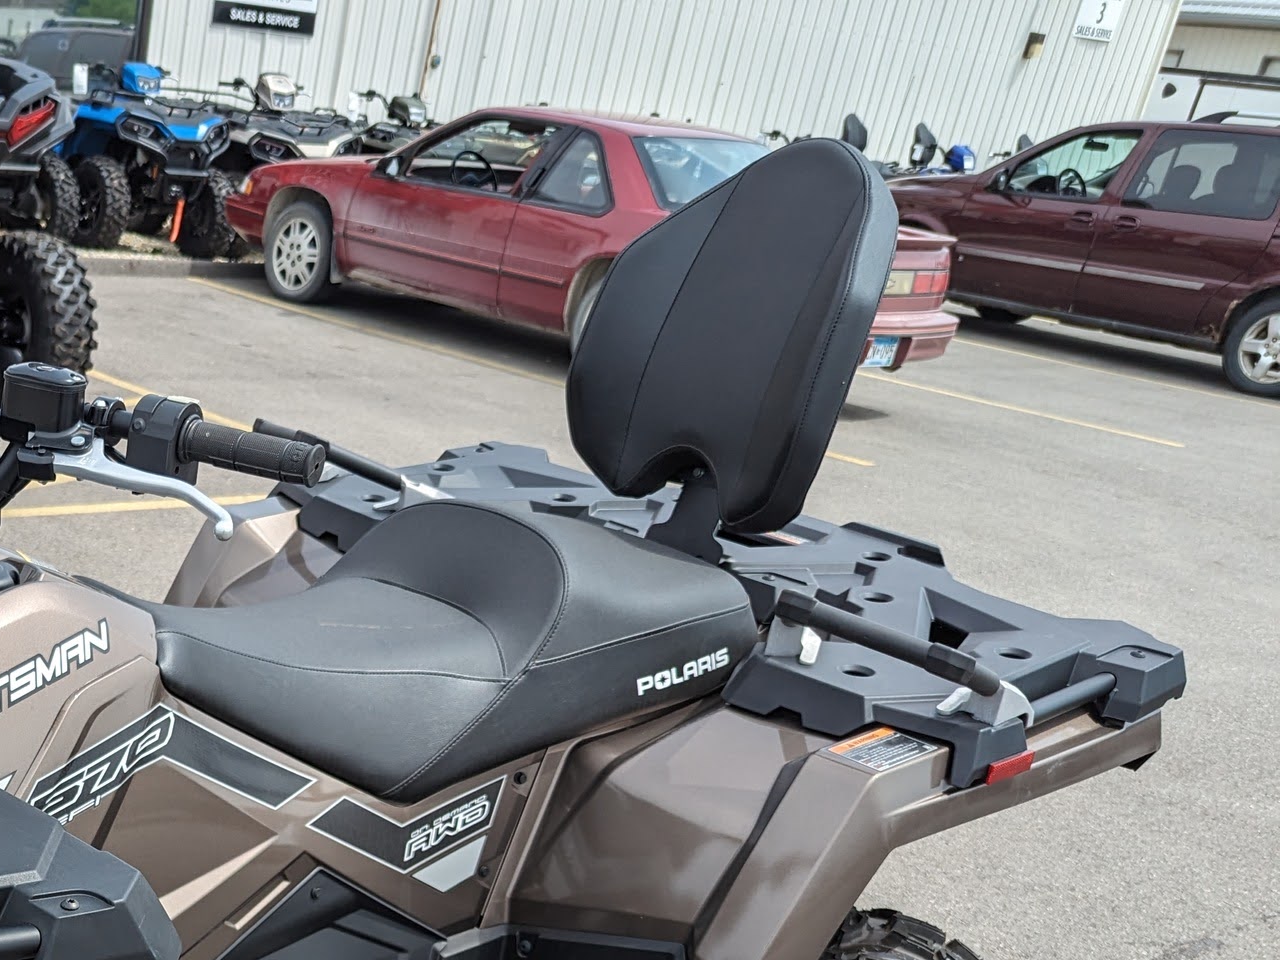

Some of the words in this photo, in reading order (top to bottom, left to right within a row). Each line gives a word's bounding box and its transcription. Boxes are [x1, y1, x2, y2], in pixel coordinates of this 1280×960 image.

[230, 7, 257, 22] SALES
[258, 12, 265, 24] &
[266, 13, 300, 28] SERVICE
[1075, 25, 1091, 37] SALES
[1095, 28, 1113, 39] SERVICE
[637, 647, 730, 696] POLARIS
[403, 801, 491, 862] AWD
